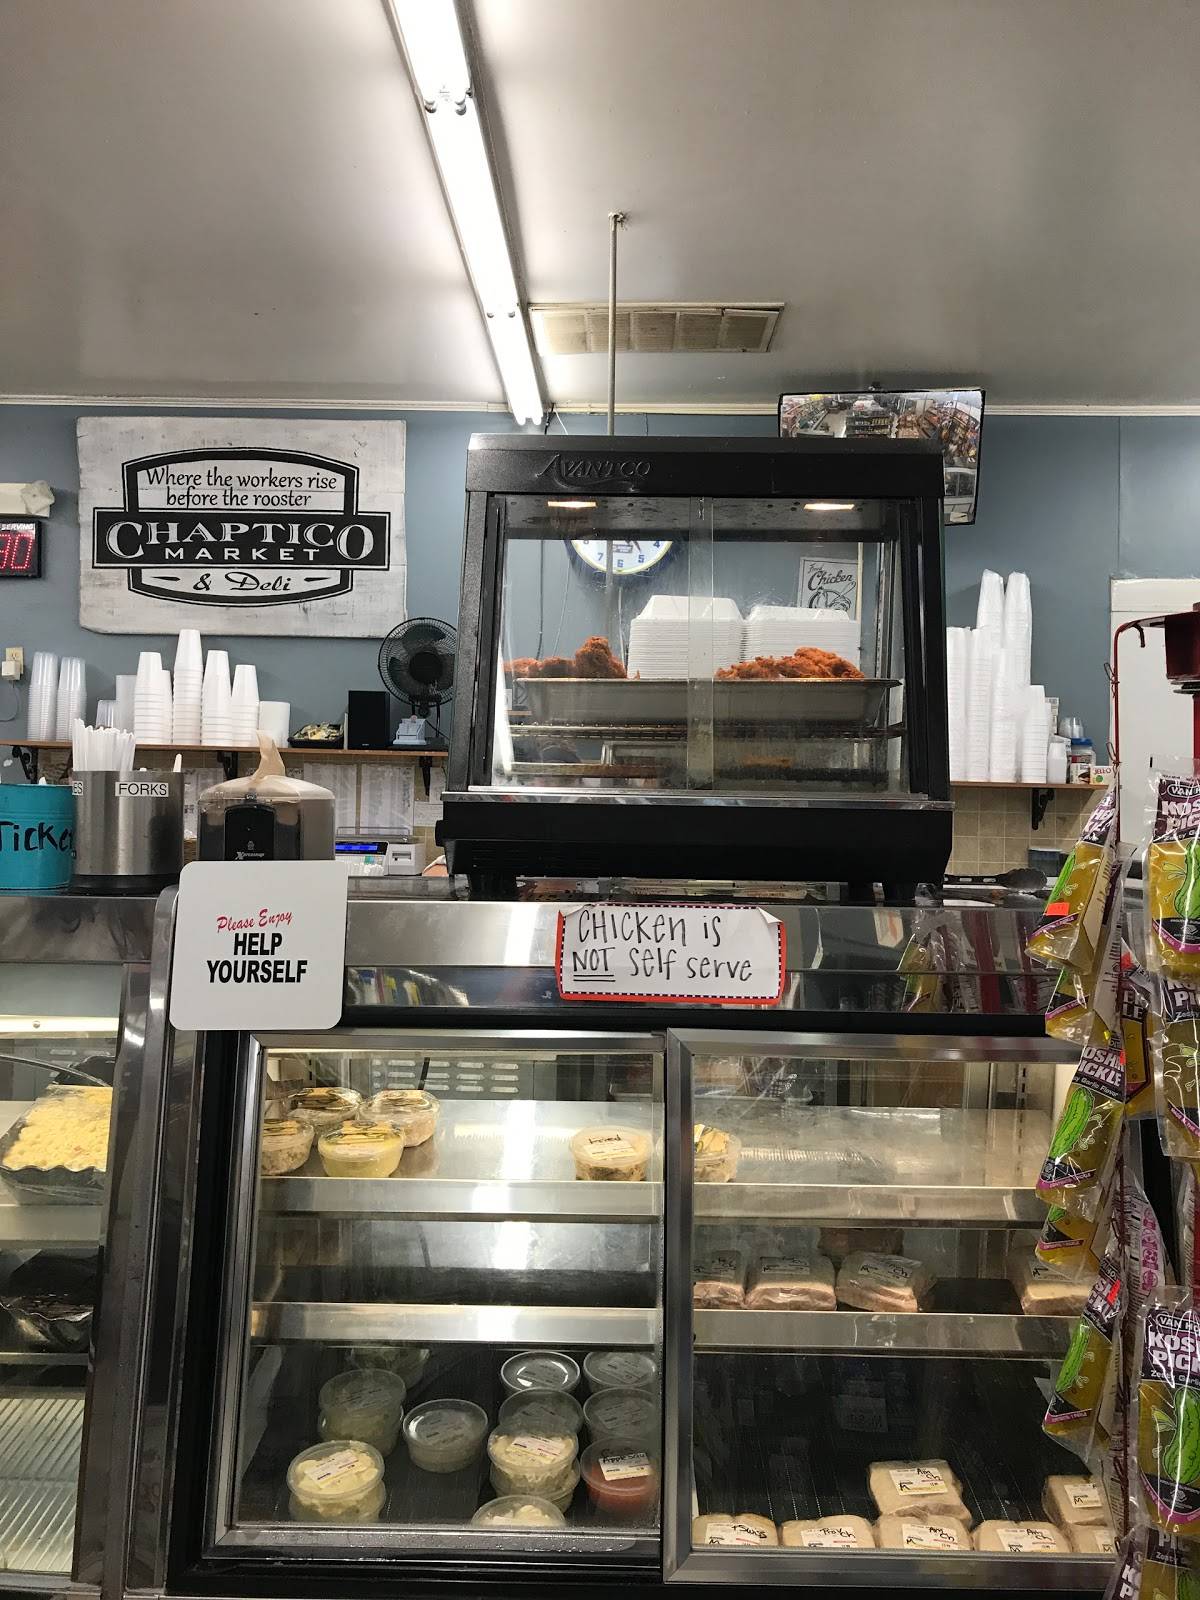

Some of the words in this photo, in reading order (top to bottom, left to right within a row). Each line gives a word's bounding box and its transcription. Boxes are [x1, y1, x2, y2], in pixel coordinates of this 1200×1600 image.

[147, 466, 202, 486] Where
[207, 466, 232, 486] the
[236, 468, 303, 488] workers
[307, 472, 337, 489] rise
[166, 486, 218, 508] before
[222, 487, 248, 506] the
[253, 489, 311, 506] rooster
[106, 521, 374, 560] CHAPTICO
[165, 547, 320, 560] MARKET
[193, 573, 212, 591] &
[224, 571, 292, 591] Deli
[807, 569, 853, 591] Chicken
[118, 783, 167, 796] FORKS
[216, 916, 255, 933] Please
[258, 908, 293, 928] Enjoy
[703, 915, 721, 947] is
[233, 932, 283, 956] HELP
[207, 960, 308, 983] YOURSELF
[573, 947, 615, 972] NOT
[687, 957, 752, 981] serve
[1160, 1316, 1182, 1329] VAN
